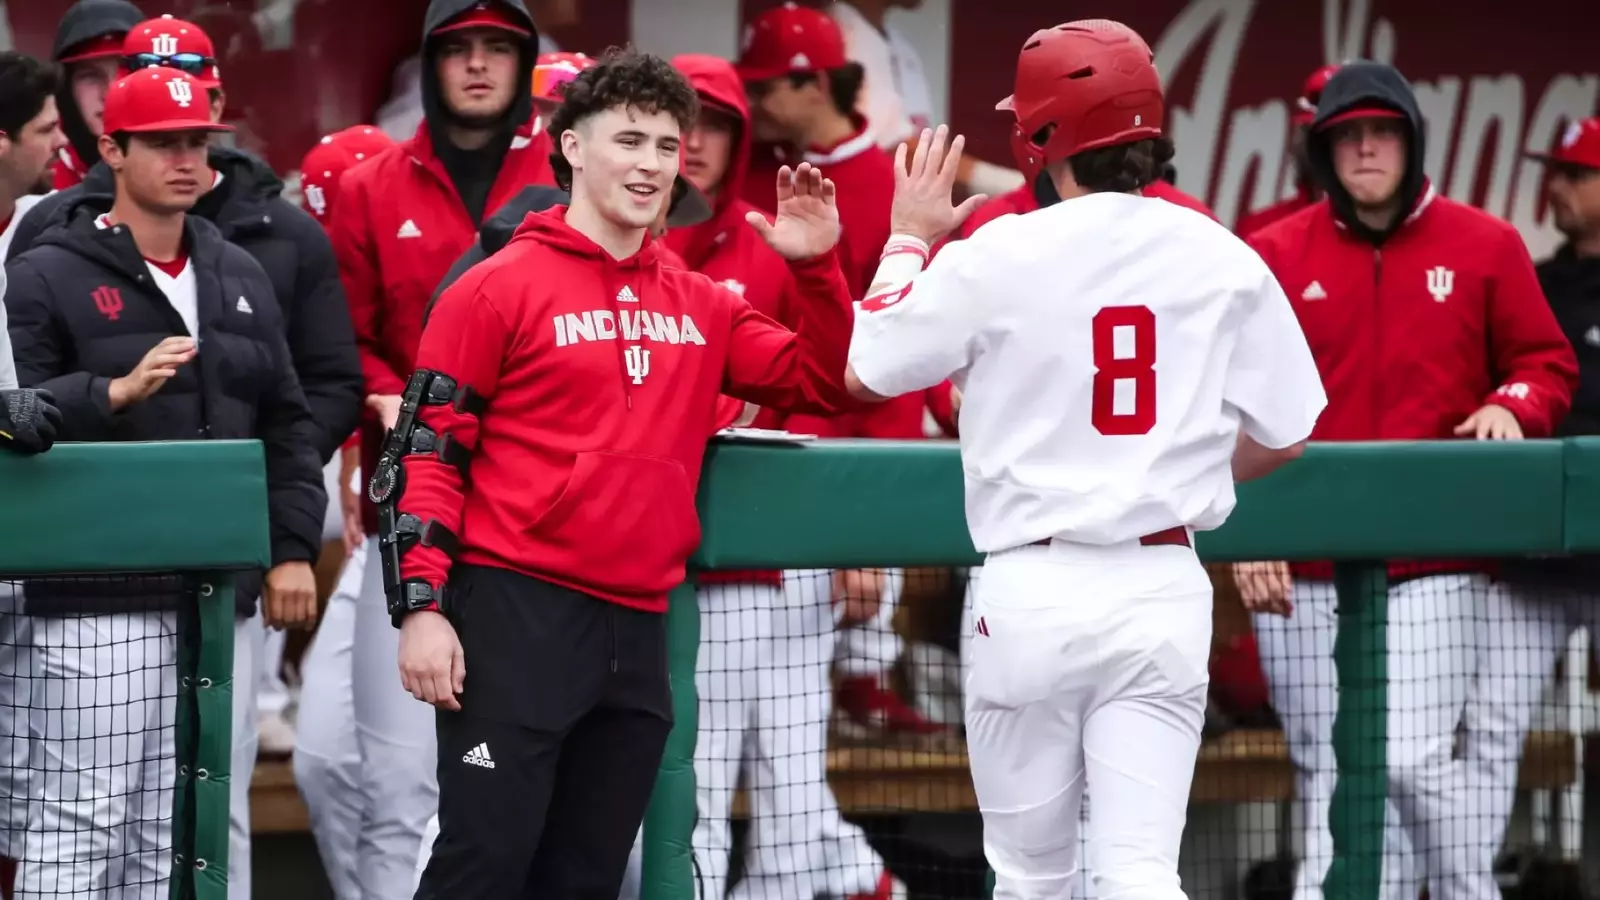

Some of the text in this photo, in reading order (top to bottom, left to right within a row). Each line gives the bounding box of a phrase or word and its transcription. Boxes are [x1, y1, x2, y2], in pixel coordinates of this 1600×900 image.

[1134, 114, 1142, 126] 8
[553, 309, 707, 347] INDIANA
[1091, 304, 1157, 436] 8
[462, 754, 495, 769] adidas
